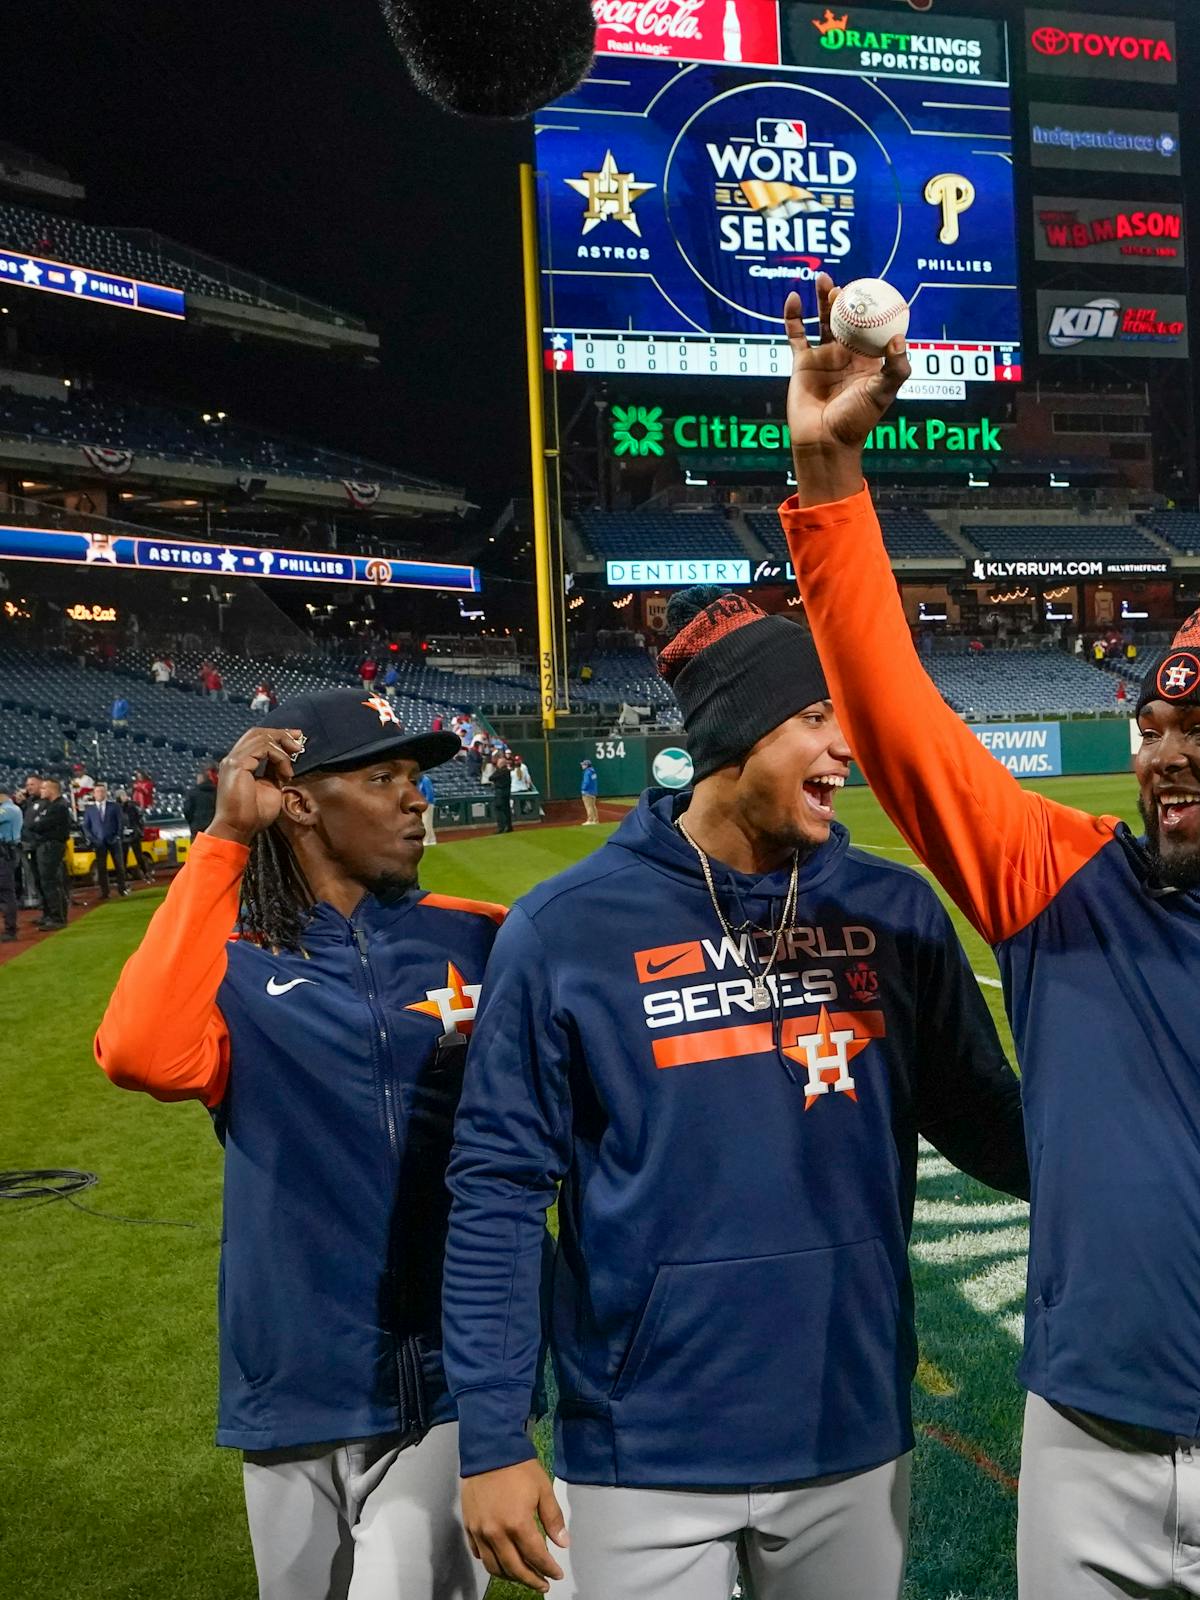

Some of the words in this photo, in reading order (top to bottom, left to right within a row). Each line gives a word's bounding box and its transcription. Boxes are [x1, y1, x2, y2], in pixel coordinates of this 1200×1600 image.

[592, 0, 703, 39] oca-Cola
[607, 40, 633, 52] Real
[635, 42, 672, 55] Magic
[820, 28, 982, 58] DRAFTKINGS
[1068, 32, 1172, 62] TOYOTA
[860, 51, 981, 75] SPORTSBOOK
[1032, 126, 1155, 150] Independence
[706, 143, 858, 185] WORLD
[720, 215, 852, 256] SERIES
[577, 245, 650, 260] ASTROS
[917, 258, 993, 273] PHILLIES
[586, 343, 594, 354] 0
[617, 344, 625, 355] 0
[648, 345, 655, 356] 0
[679, 346, 687, 356] 0
[709, 346, 717, 357] 5
[739, 347, 747, 358] 0
[770, 348, 777, 359] 0
[587, 358, 594, 369] 0
[618, 358, 625, 369] 0
[649, 359, 656, 370] 0
[680, 360, 687, 371] 0
[710, 361, 718, 372] 0
[740, 362, 747, 372] 0
[770, 362, 778, 373] 0
[926, 354, 939, 375] 0
[951, 355, 964, 375] 0
[975, 355, 988, 376] 0
[926, 417, 1002, 452] Park
[149, 547, 213, 565] ASTROS
[279, 557, 344, 575] PHILLIES
[611, 564, 744, 581] DENTISTRY
[754, 561, 781, 582] for
[987, 562, 1103, 576] KLYRRUM.COM
[595, 741, 626, 759] 334
[700, 926, 876, 970] WORLD
[643, 969, 838, 1028] SERIES
